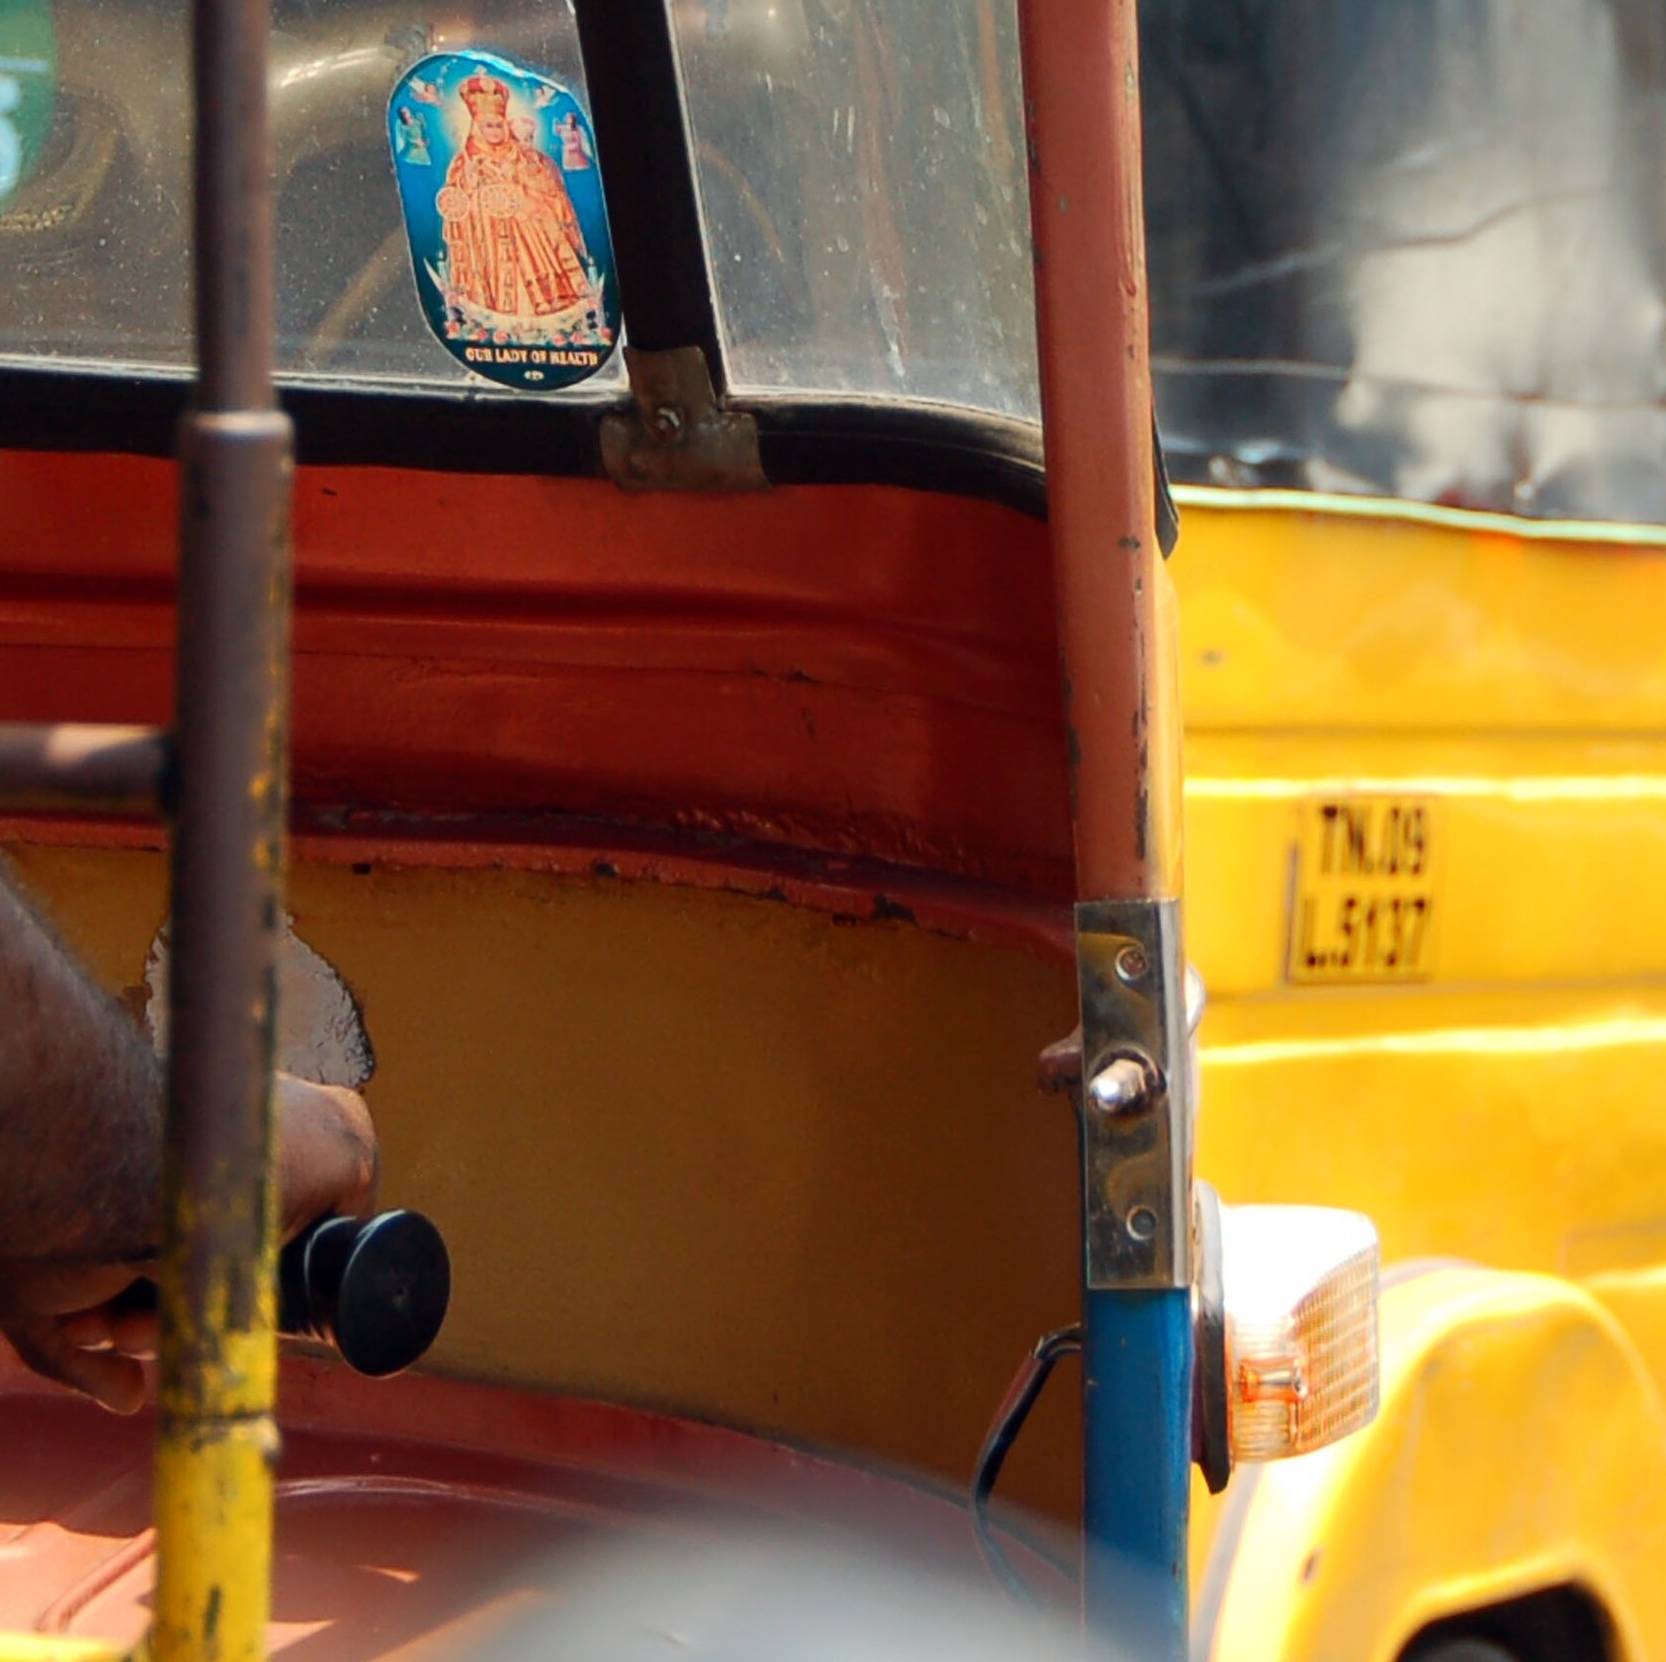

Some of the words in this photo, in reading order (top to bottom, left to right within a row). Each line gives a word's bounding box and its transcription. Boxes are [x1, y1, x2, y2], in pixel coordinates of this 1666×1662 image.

[465, 346, 493, 362] OUR
[495, 348, 527, 363] LADY
[531, 349, 547, 364] OF
[550, 350, 598, 366] HEALTH
